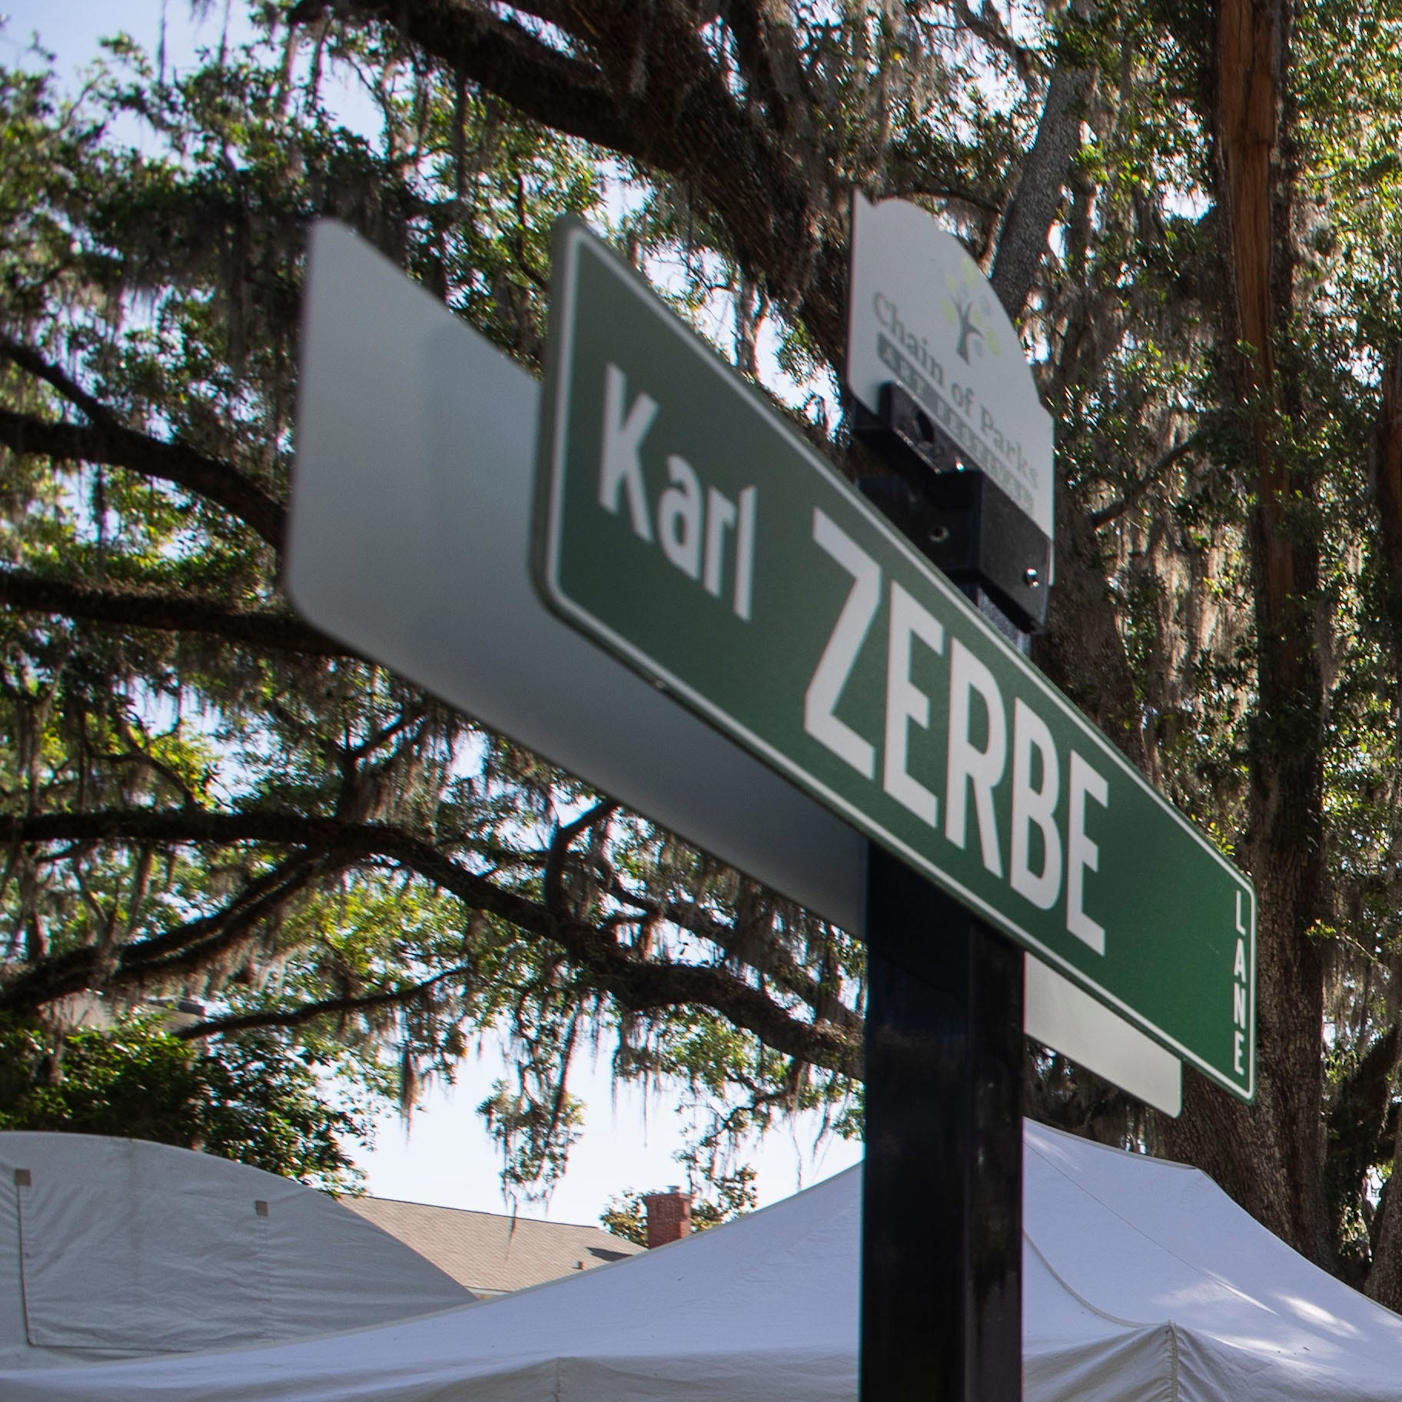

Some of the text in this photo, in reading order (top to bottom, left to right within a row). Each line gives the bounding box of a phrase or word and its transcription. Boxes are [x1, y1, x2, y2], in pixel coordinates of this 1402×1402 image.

[874, 292, 1039, 489] Chain of Parks
[600, 362, 1108, 957] Karl ZERBE
[1233, 890, 1246, 1075] LANE
